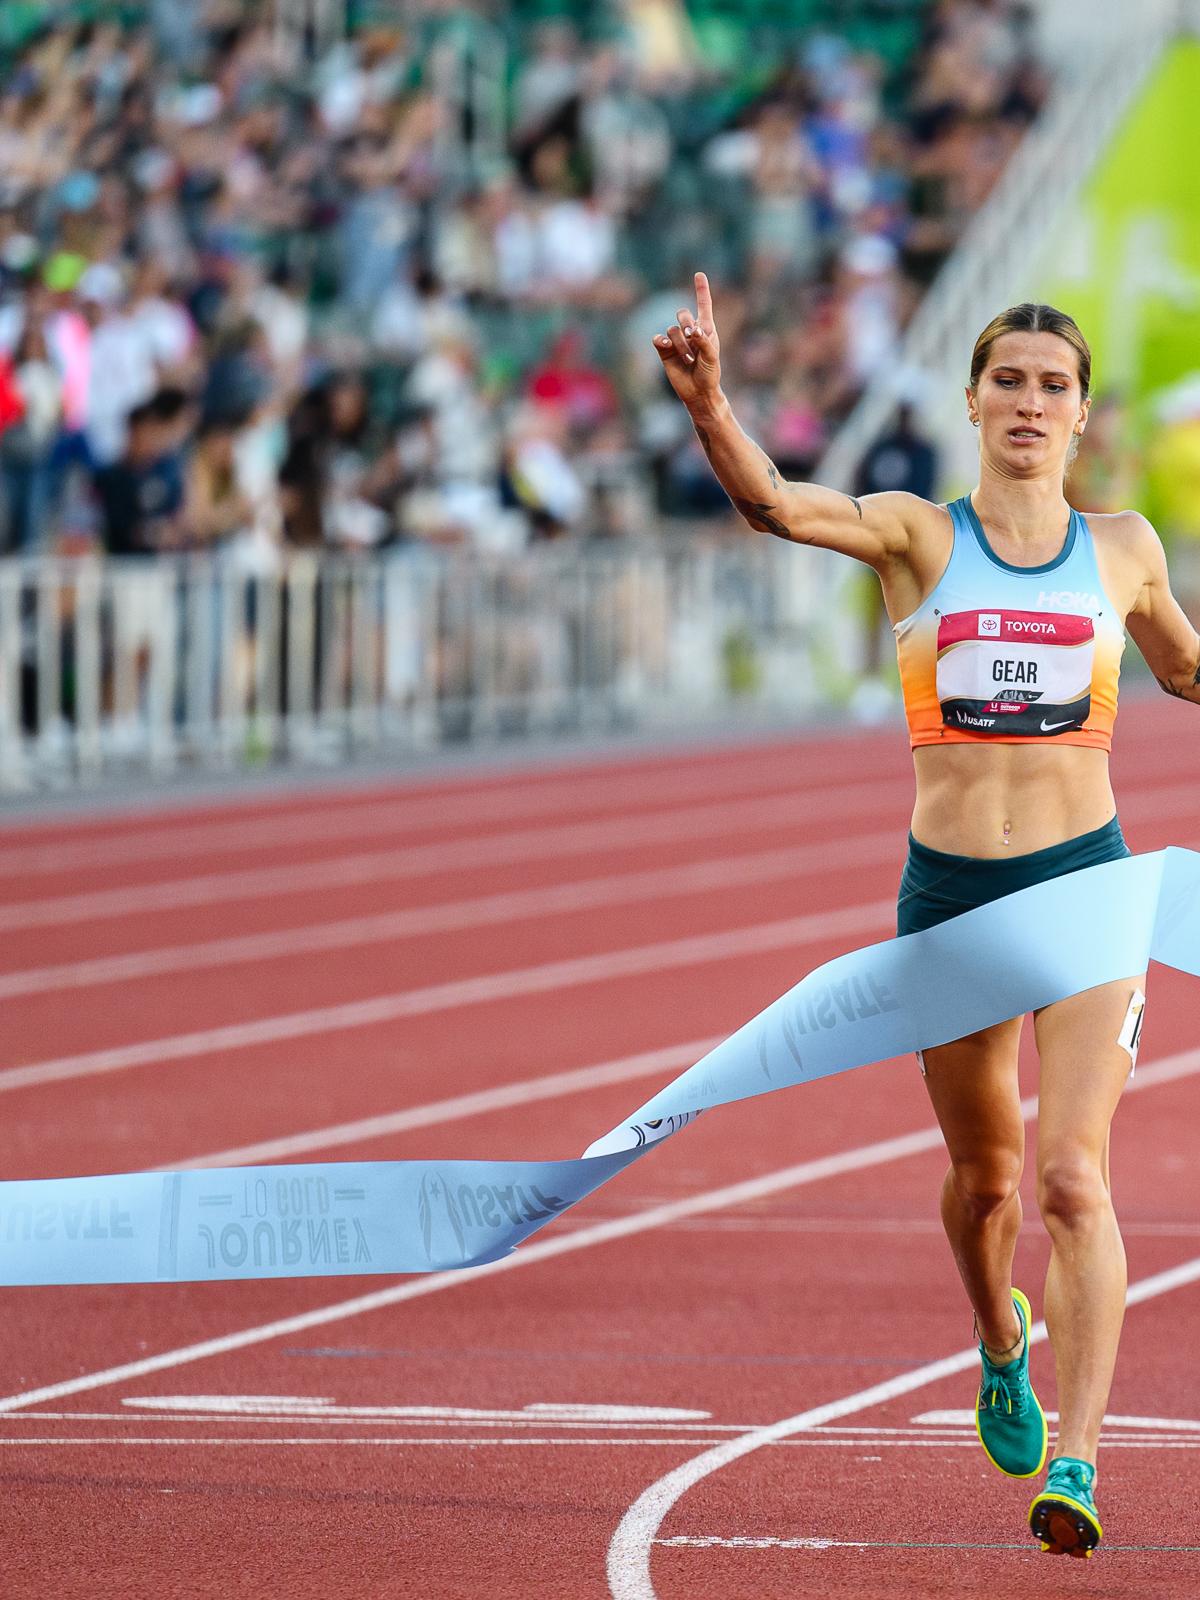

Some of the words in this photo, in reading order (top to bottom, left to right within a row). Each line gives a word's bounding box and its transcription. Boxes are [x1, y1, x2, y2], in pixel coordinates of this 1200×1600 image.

[1035, 591, 1099, 610] HOKA
[1005, 620, 1056, 635] TOYOTA
[992, 659, 1038, 684] GEAR
[967, 717, 996, 728] USATF
